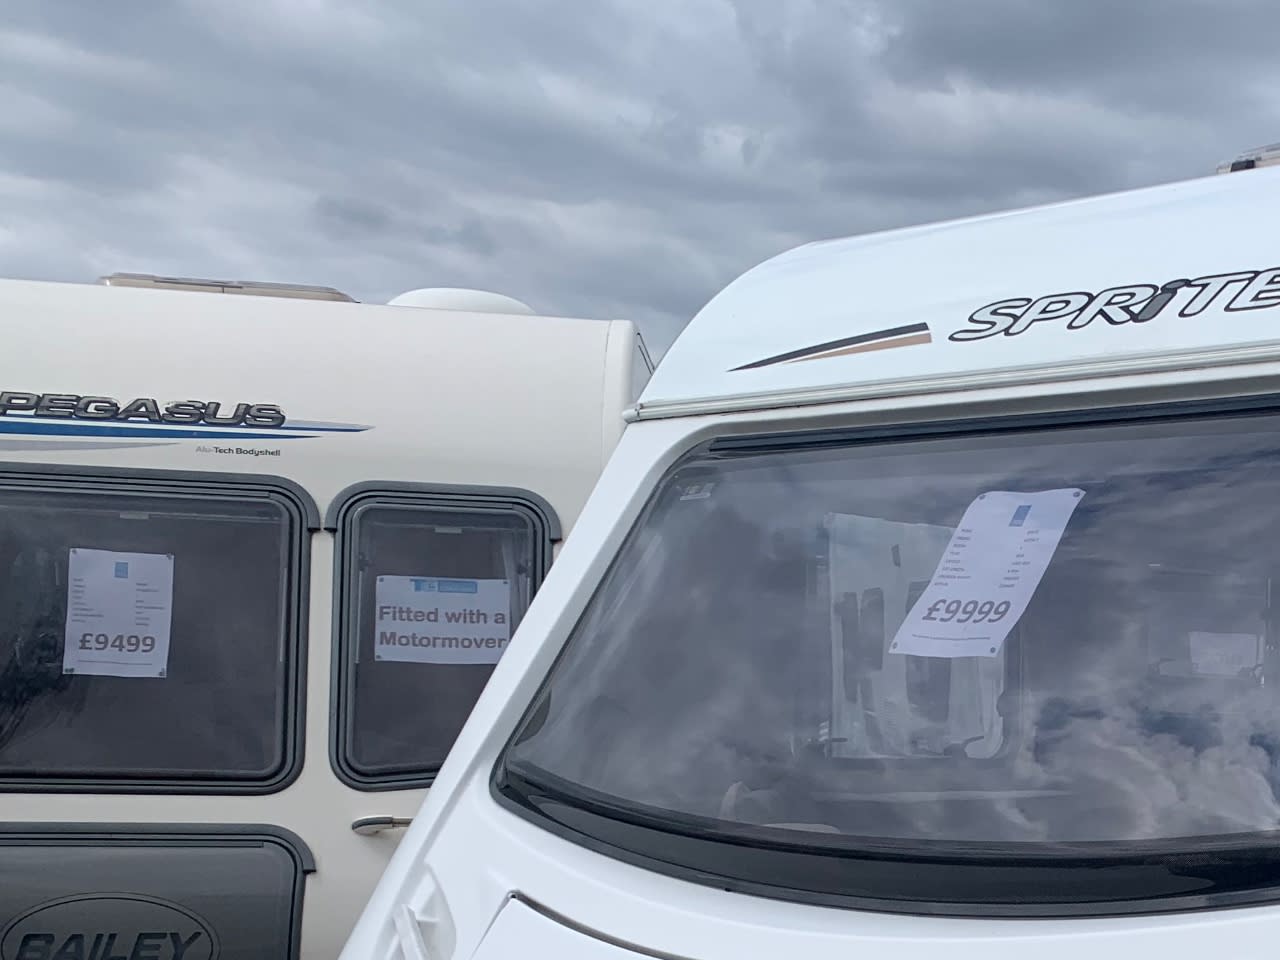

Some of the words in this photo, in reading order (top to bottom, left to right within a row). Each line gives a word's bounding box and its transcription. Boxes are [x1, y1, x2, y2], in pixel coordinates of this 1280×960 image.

[0, 391, 286, 427] PEGASUS
[236, 448, 281, 457] Bodyshell
[379, 606, 439, 623] Fitted
[445, 608, 489, 624] with
[494, 612, 506, 624] a
[922, 599, 1011, 623] £9999
[79, 633, 156, 653] £9499
[379, 632, 508, 649] Motormover
